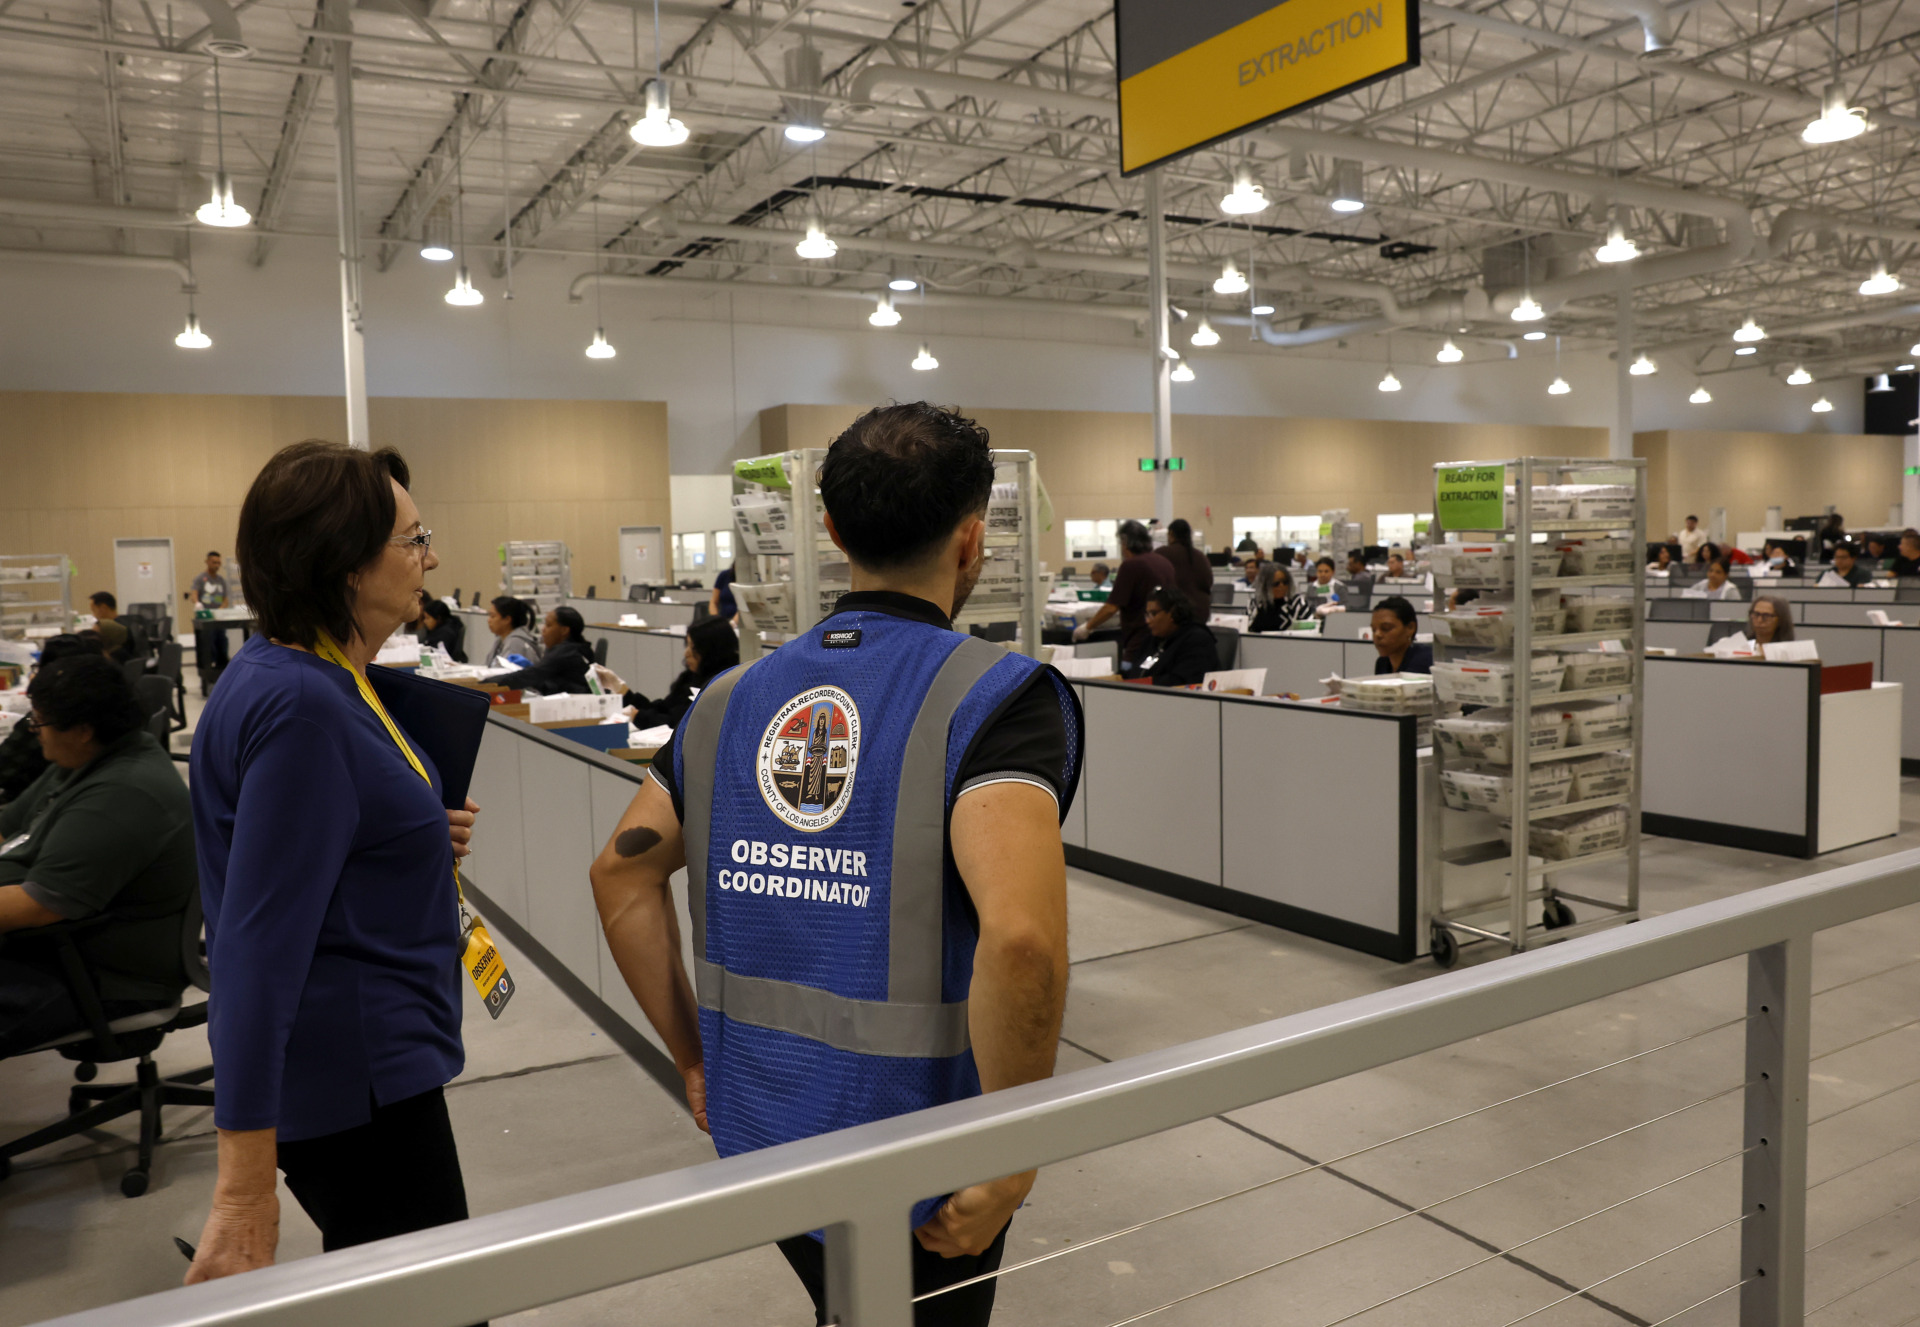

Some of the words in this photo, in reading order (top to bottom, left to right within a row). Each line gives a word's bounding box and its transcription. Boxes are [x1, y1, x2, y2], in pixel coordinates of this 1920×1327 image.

[1238, 2, 1383, 87] EXTRACTION
[1440, 490, 1498, 502] EXTRACTION
[1445, 473, 1475, 484] READY
[1477, 471, 1496, 483] FOR
[988, 519, 1020, 528] SERVIC
[764, 689, 855, 748] REGISTRAR-RECORDER/COUNTY
[761, 768, 778, 803] COUNTY
[775, 802, 787, 813] OF
[785, 811, 800, 824] LOS
[799, 815, 829, 828] ANGELES
[832, 770, 855, 817] CALIFORNIA
[731, 839, 868, 877] OBSERVER
[718, 869, 871, 908] COORDINATOR
[471, 945, 497, 981] OBSERVER
